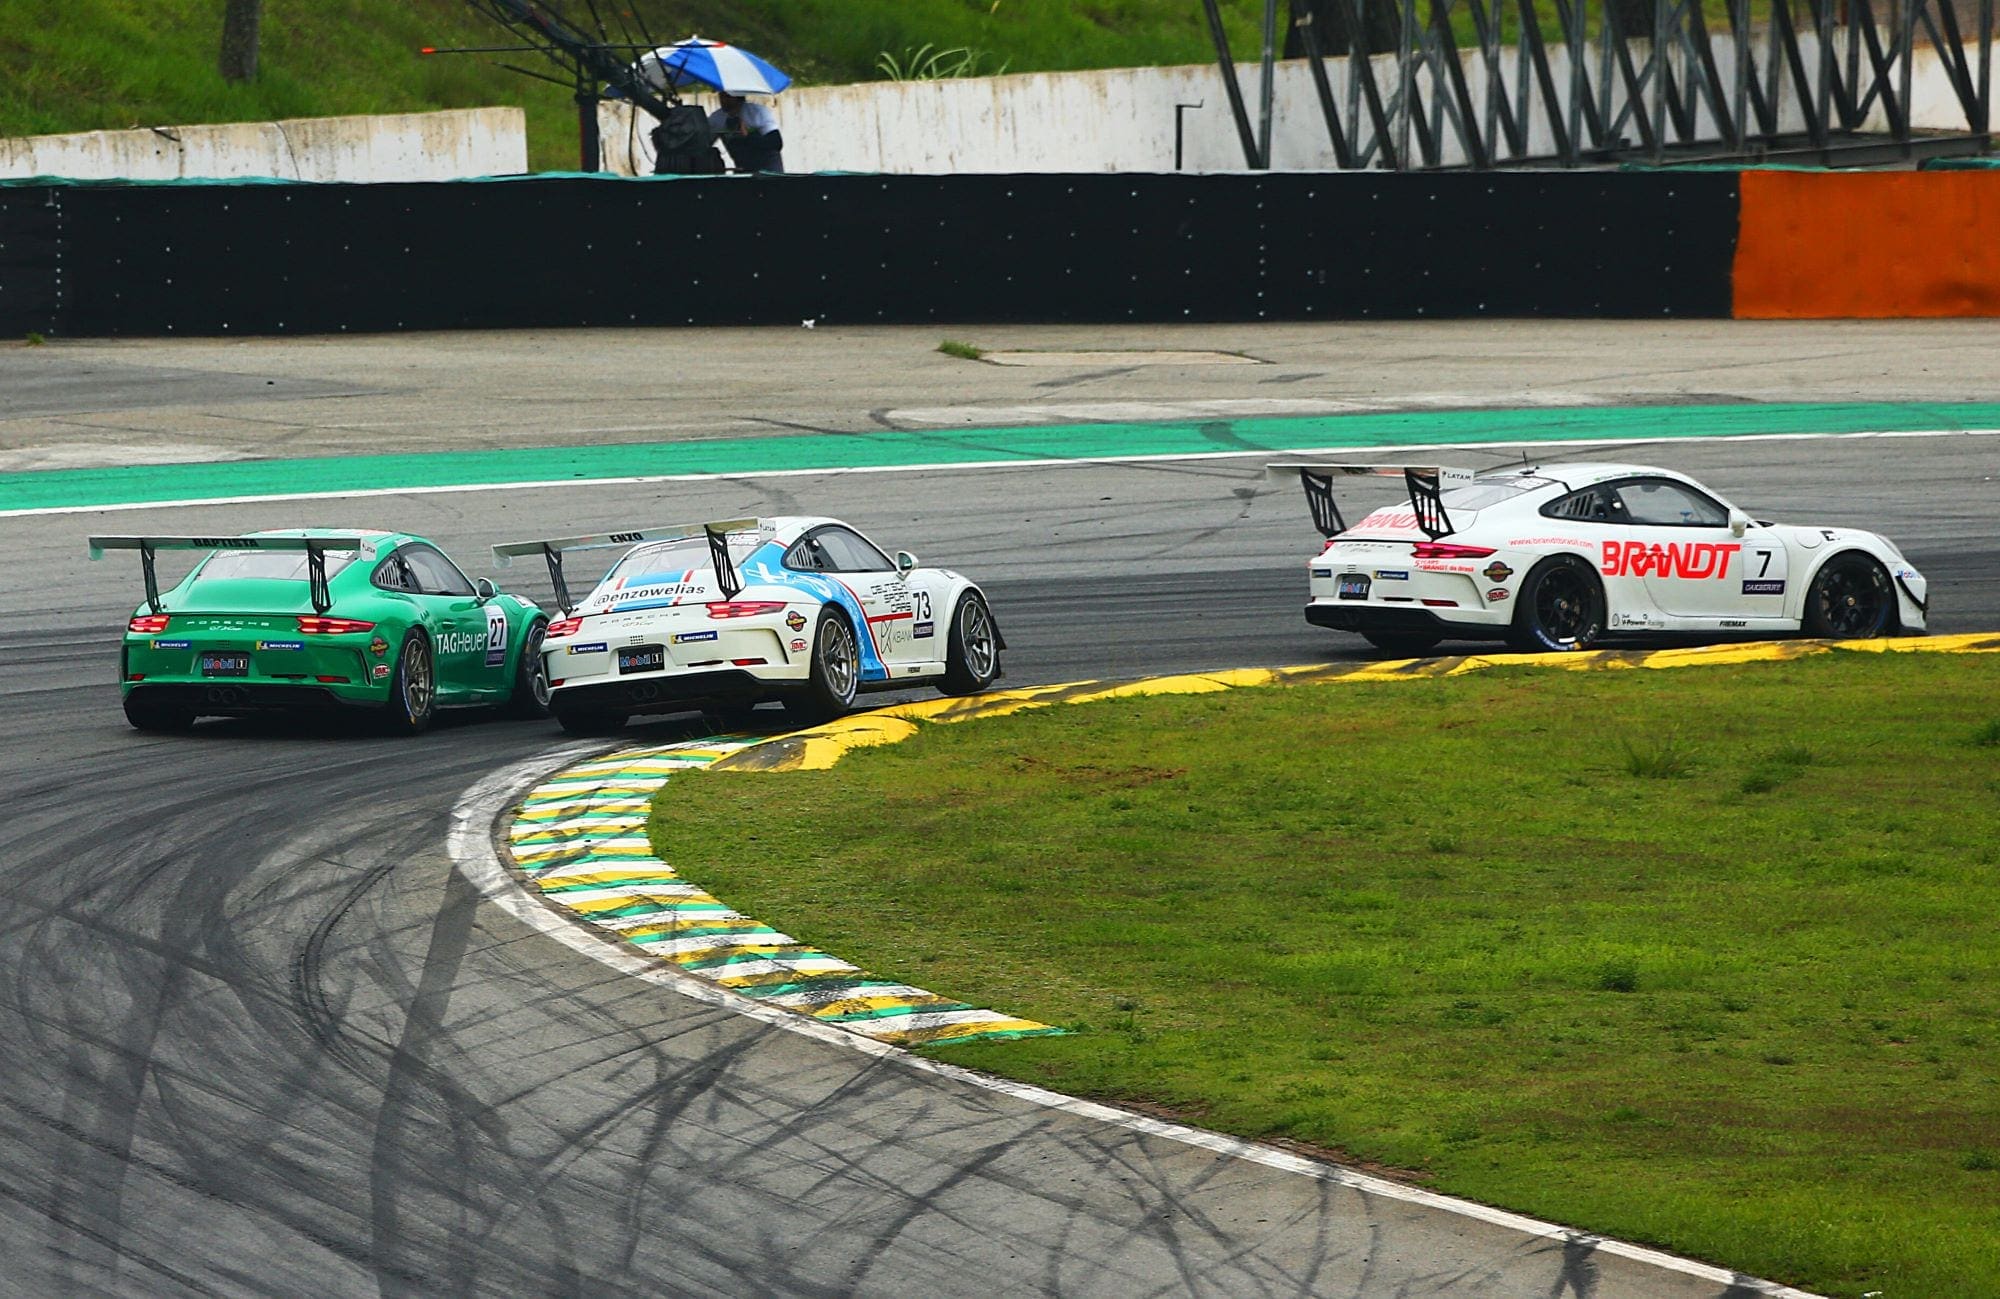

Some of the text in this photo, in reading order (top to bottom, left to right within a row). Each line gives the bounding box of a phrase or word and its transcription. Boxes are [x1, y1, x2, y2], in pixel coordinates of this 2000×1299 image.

[609, 532, 644, 544] ENZO
[1600, 541, 1741, 579] BRANDT
[1756, 550, 1772, 578] 7
[1744, 583, 1782, 592] OAKBERRY
[593, 584, 706, 607] @enzowelias
[884, 591, 909, 603] SPORT
[891, 601, 911, 613] CARS
[913, 590, 932, 620] 73
[600, 612, 680, 625] PORSCHE
[489, 617, 505, 648] 27
[683, 633, 714, 641] MICHELIN
[203, 658, 234, 670] Mobil
[620, 653, 650, 668] Mobil
